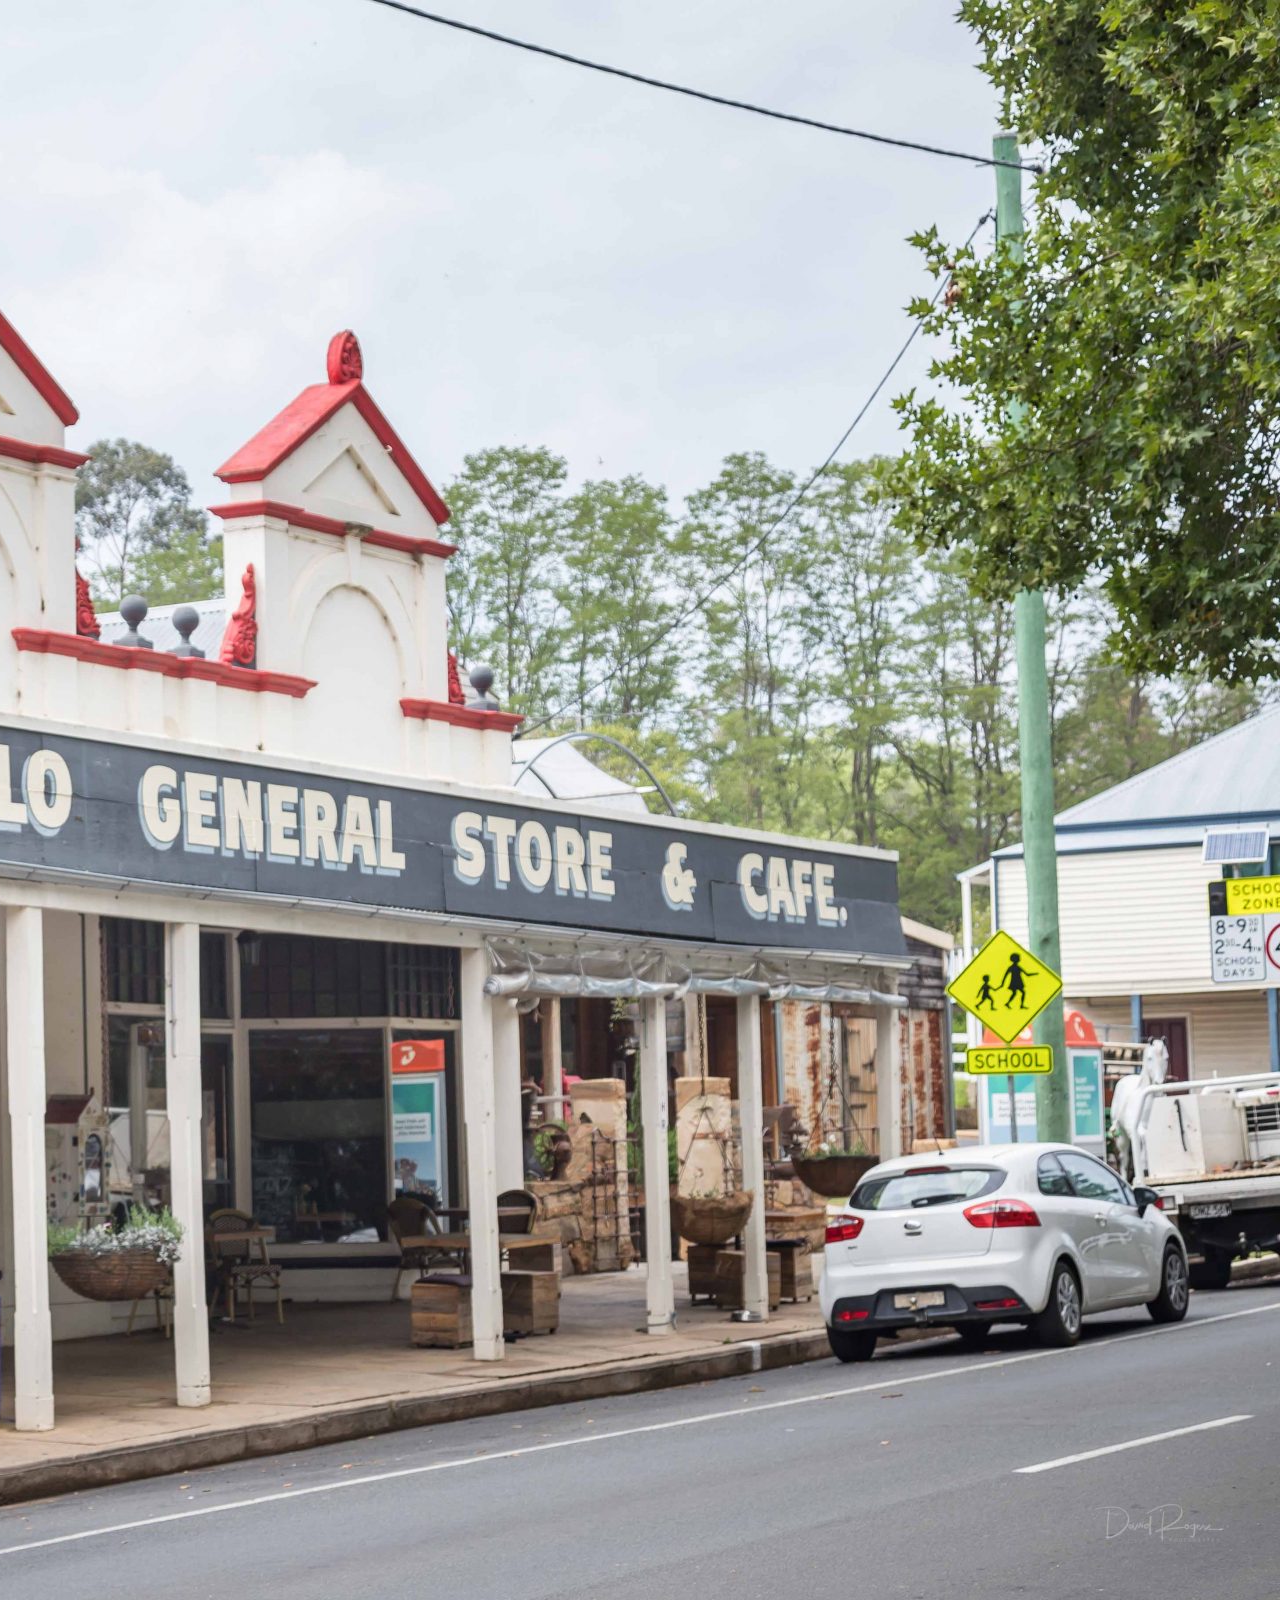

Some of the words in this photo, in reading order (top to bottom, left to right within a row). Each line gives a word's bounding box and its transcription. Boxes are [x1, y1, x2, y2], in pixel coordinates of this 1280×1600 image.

[138, 764, 407, 878] GENERAL
[450, 810, 616, 902] STORE
[661, 841, 697, 912] &
[1216, 956, 1261, 967] SCHOOL
[1223, 968, 1255, 978] DAYS
[975, 1052, 1045, 1069] SCHOOL
